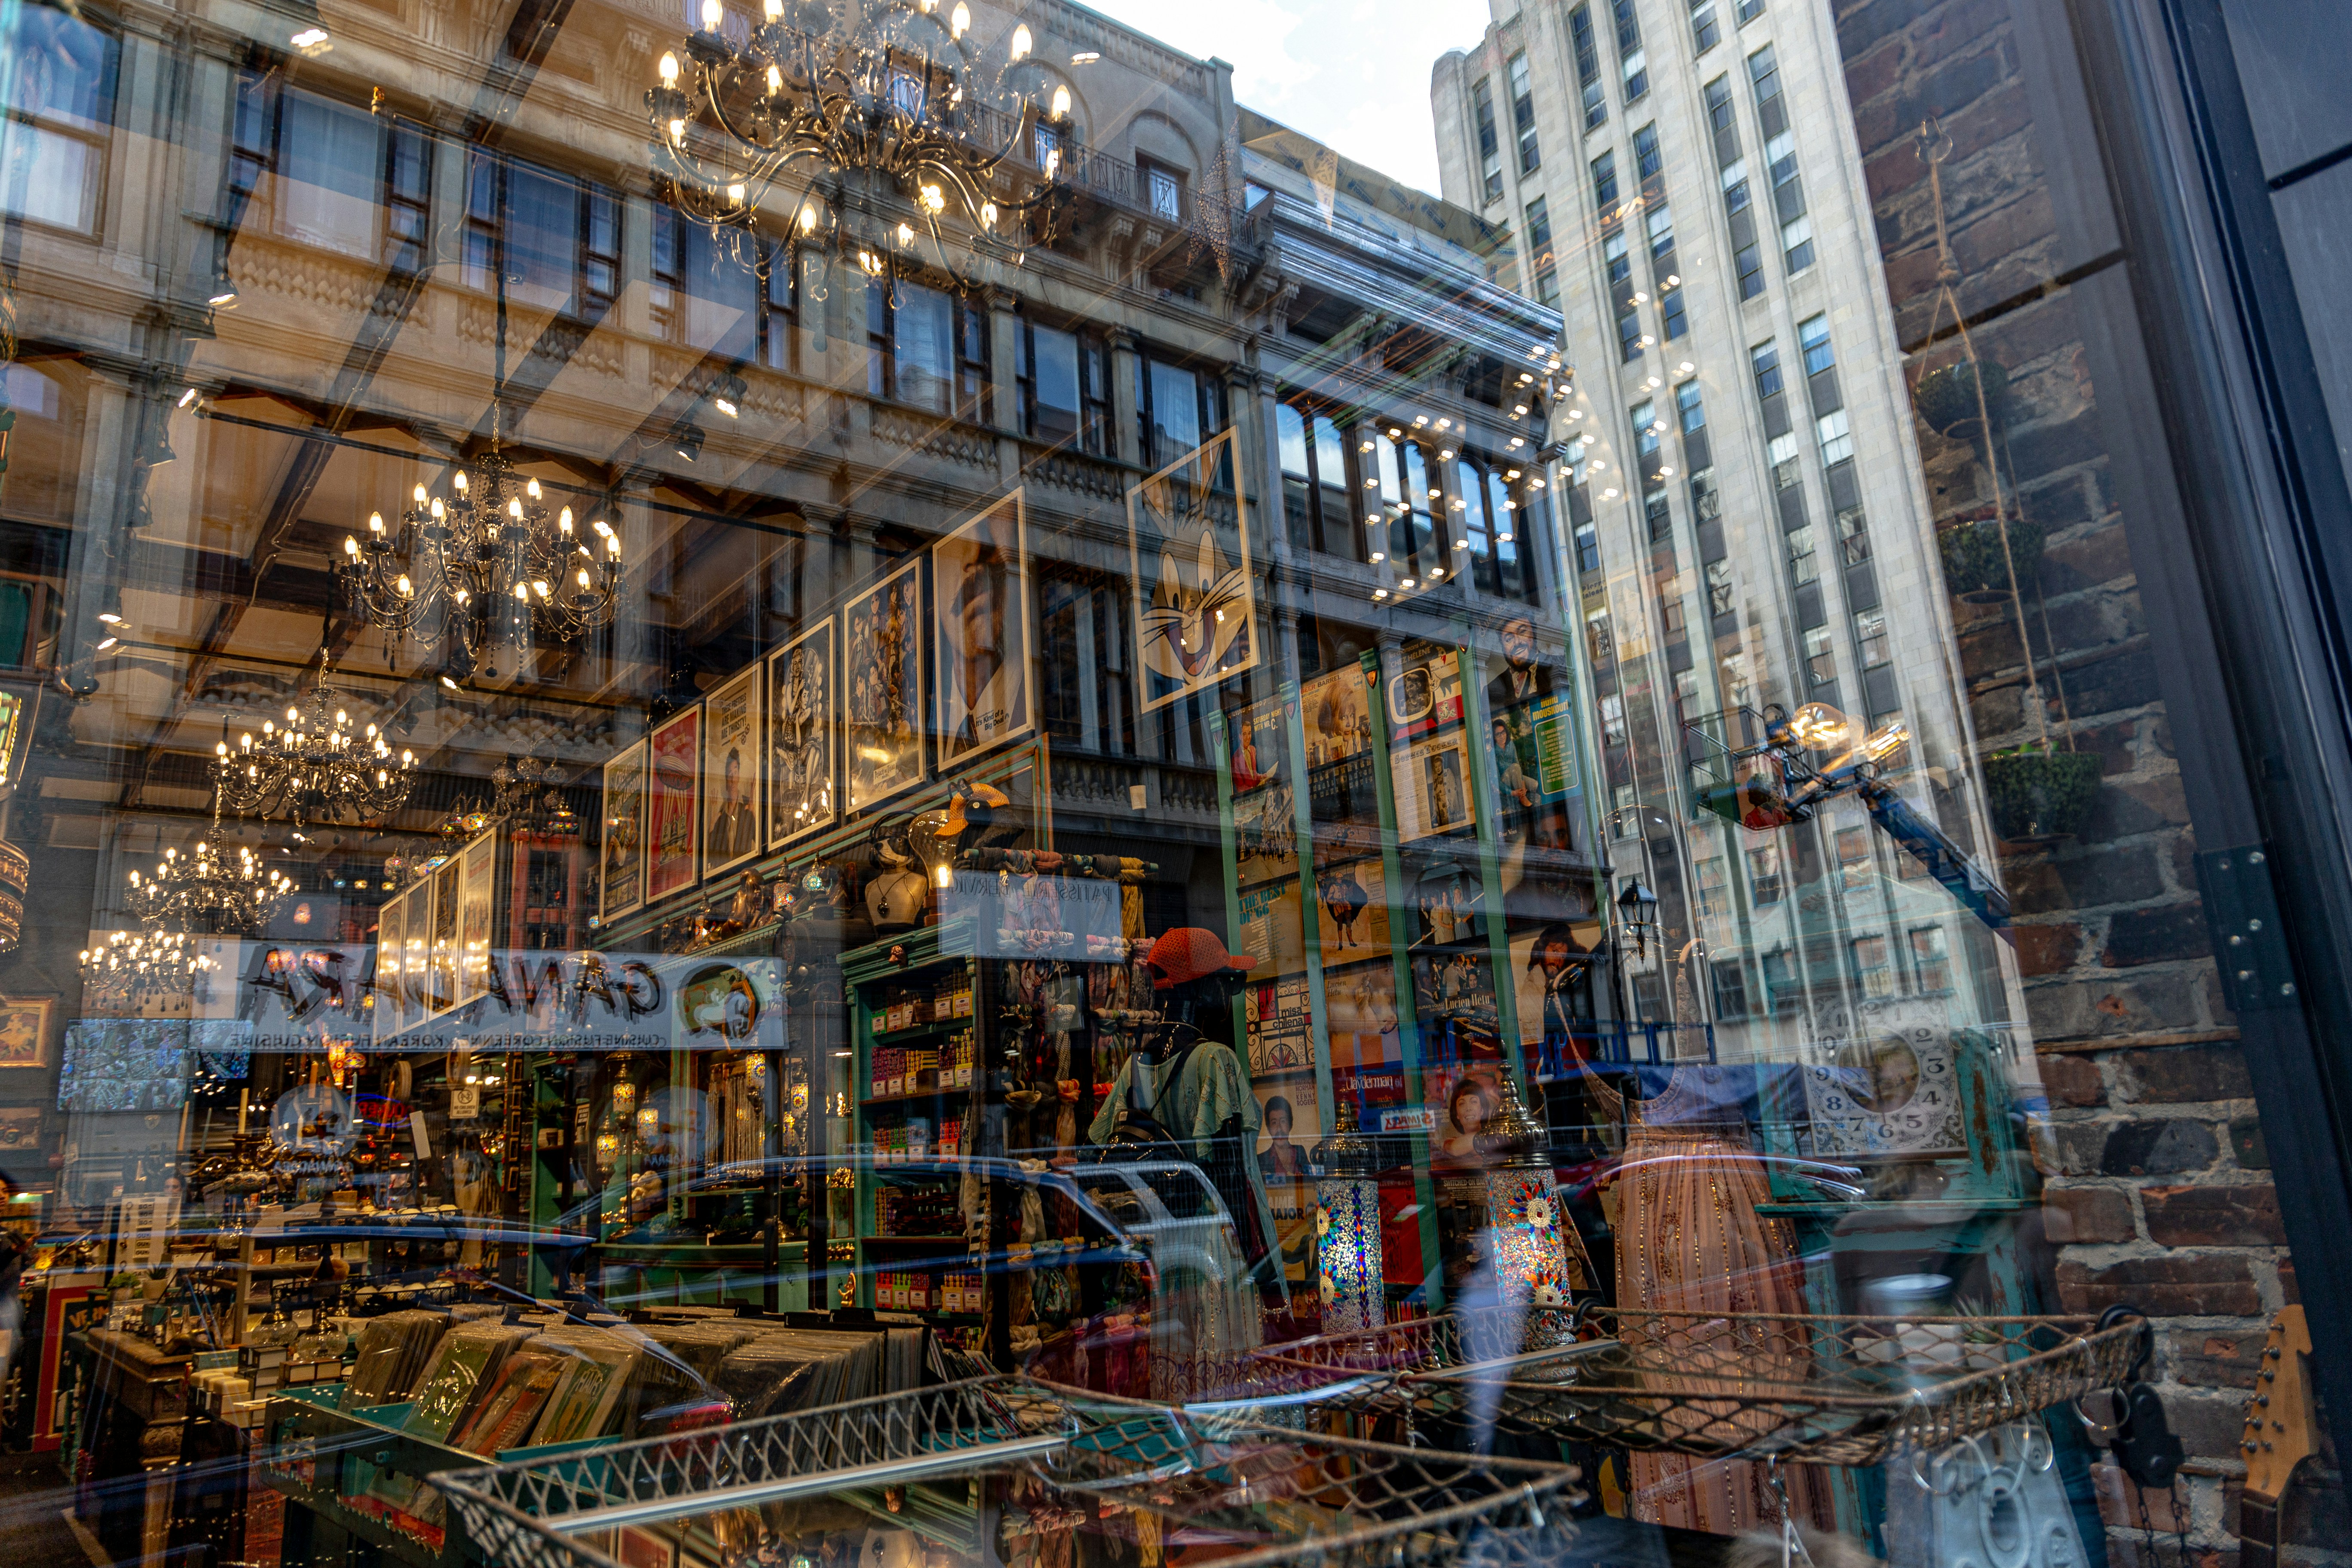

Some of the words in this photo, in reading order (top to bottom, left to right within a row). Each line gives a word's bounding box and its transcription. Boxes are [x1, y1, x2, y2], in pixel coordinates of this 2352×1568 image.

[1396, 643, 1419, 655] chansons
[1301, 684, 1315, 694] BEER
[1317, 674, 1341, 688] BARREL
[1343, 666, 1362, 678] PIANO
[723, 702, 731, 715] THESE
[732, 692, 746, 709] PRETZELS
[730, 703, 747, 722] MAKING
[983, 713, 994, 723] Kind
[1253, 713, 1270, 725] SATURDAY
[1271, 708, 1281, 717] NIGHT
[722, 727, 728, 739] ME
[729, 715, 747, 735] THIRSTY!
[993, 716, 1004, 726] Deal
[1271, 718, 1278, 730] C.
[615, 755, 639, 788] CREATURE
[609, 798, 622, 817] BLACK
[622, 773, 642, 805] LAGOON
[1365, 865, 1382, 874] Treasure
[1369, 873, 1381, 882] Island
[1239, 893, 1259, 912] THE
[1260, 882, 1286, 903] BEST
[1240, 910, 1252, 925] OF
[1327, 979, 1346, 989] Lucien
[1445, 997, 1470, 1010] Lucien
[1471, 993, 1490, 1006] Hétu
[1281, 1006, 1302, 1018] misa
[1895, 1007, 1902, 1021] 1
[1273, 1017, 1303, 1029] chilena
[1915, 1028, 1933, 1042] 2
[1927, 1058, 1945, 1074] 3
[1816, 1067, 1830, 1081] 9
[1346, 1075, 1393, 1094] Clayderman
[1827, 1096, 1842, 1110] 8
[1922, 1090, 1942, 1105] 4
[1850, 1118, 1865, 1131] 7
[1907, 1115, 1923, 1128] 5
[1878, 1124, 1894, 1138] 6
